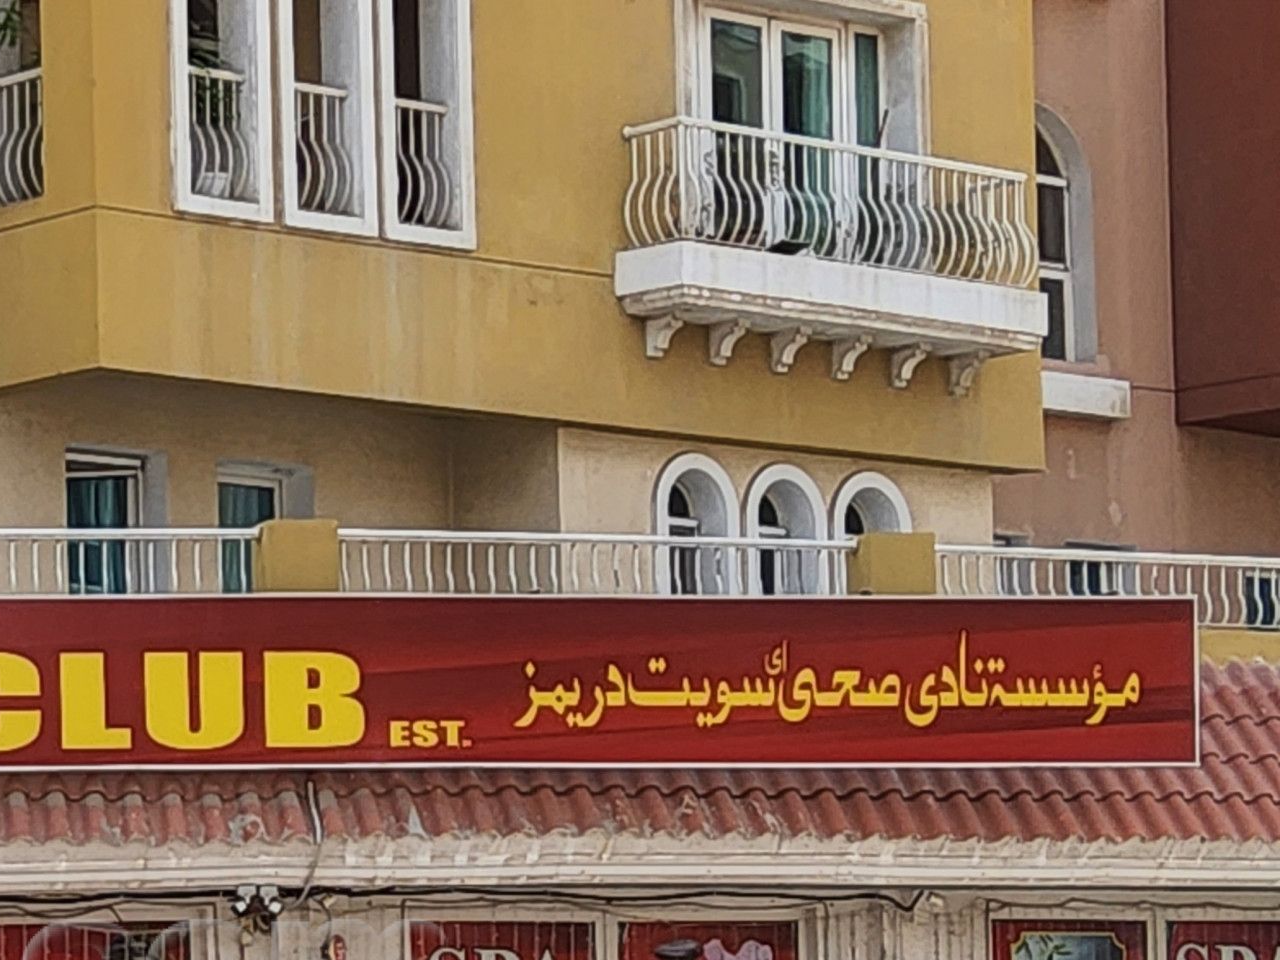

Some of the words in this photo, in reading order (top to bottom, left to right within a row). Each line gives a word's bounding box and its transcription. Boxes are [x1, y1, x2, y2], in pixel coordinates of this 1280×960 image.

[513, 660, 626, 728] دريمز
[627, 656, 776, 728] سويت
[389, 720, 471, 749] EST.
